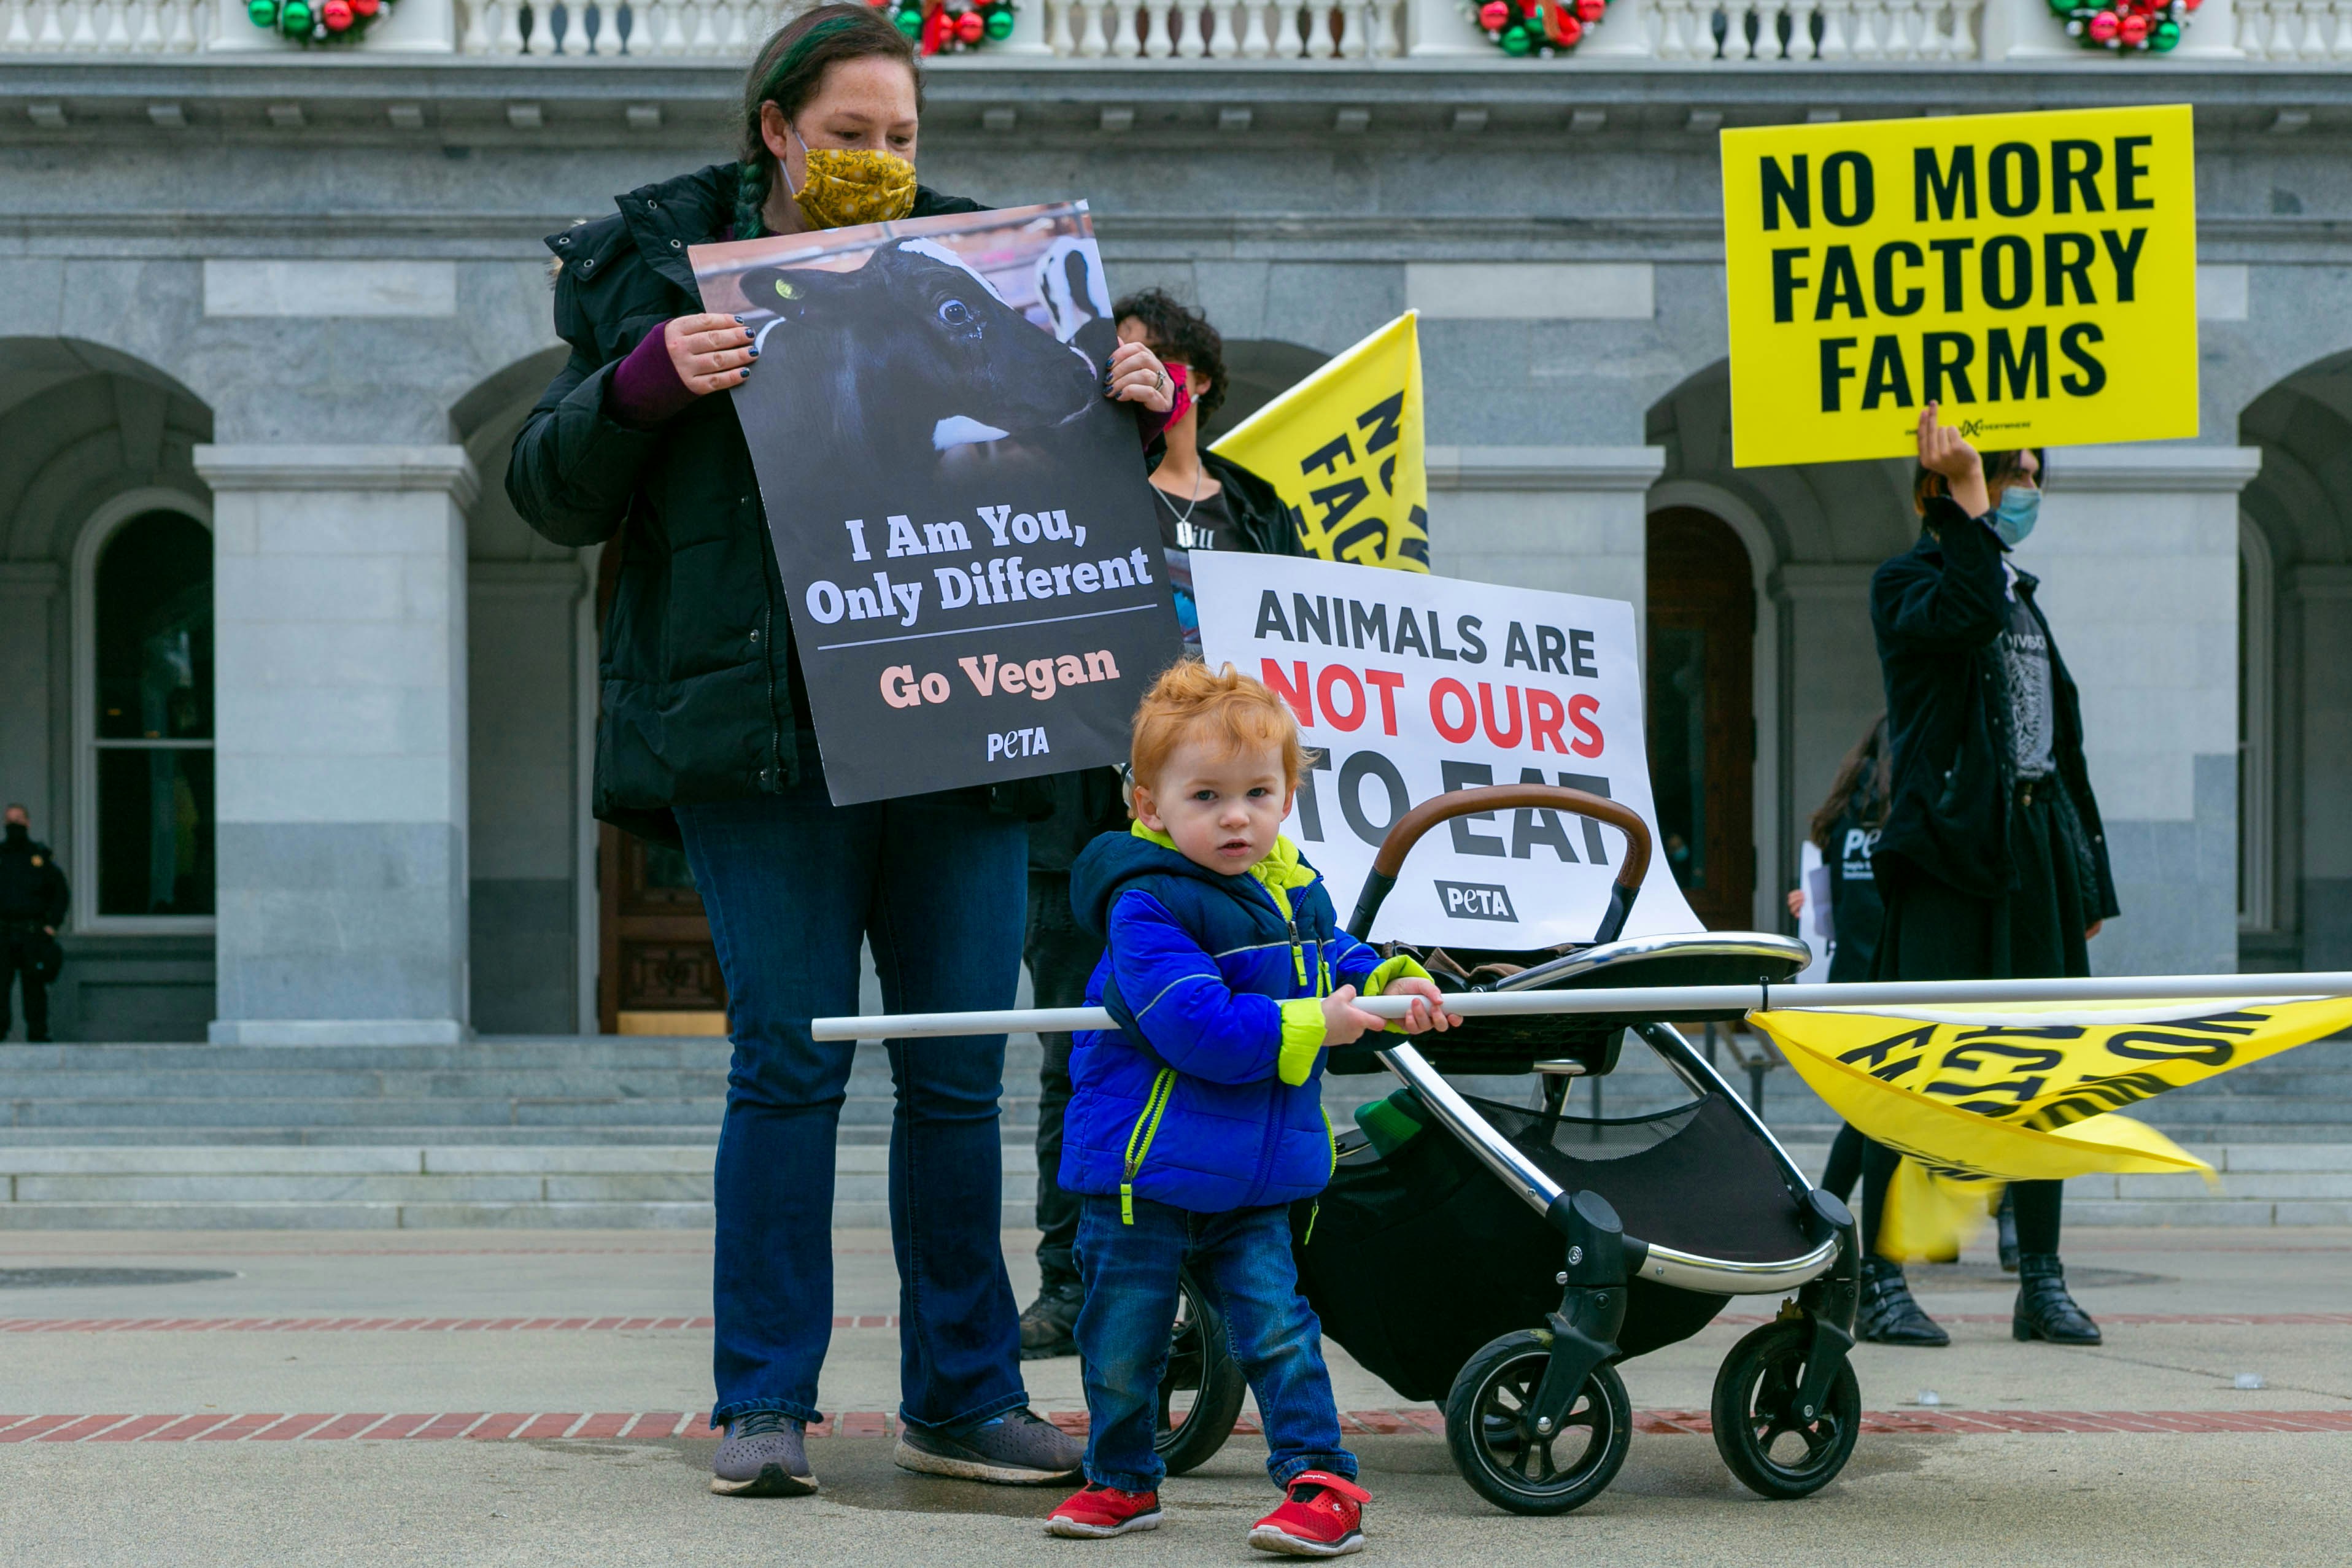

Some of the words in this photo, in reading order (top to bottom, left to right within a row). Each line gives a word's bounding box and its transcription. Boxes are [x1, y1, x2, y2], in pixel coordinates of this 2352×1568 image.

[1760, 150, 1874, 231] NO
[1914, 136, 2154, 222] MORE
[1772, 228, 2148, 323] FACTORY
[1820, 322, 2106, 413] FARMS
[845, 519, 872, 562] I
[886, 514, 972, 558] Am
[976, 504, 1086, 547] You,
[805, 571, 923, 627] Only
[933, 546, 1153, 610] Different
[880, 665, 951, 708] Go
[958, 650, 1120, 700] Vegan
[1254, 590, 1487, 664] ANIMALS
[1504, 621, 1598, 678] ARE
[1261, 658, 1404, 736] NOT
[1429, 678, 1604, 759] OURS
[1294, 746, 1411, 849] TO
[1441, 760, 1611, 866] EAT
